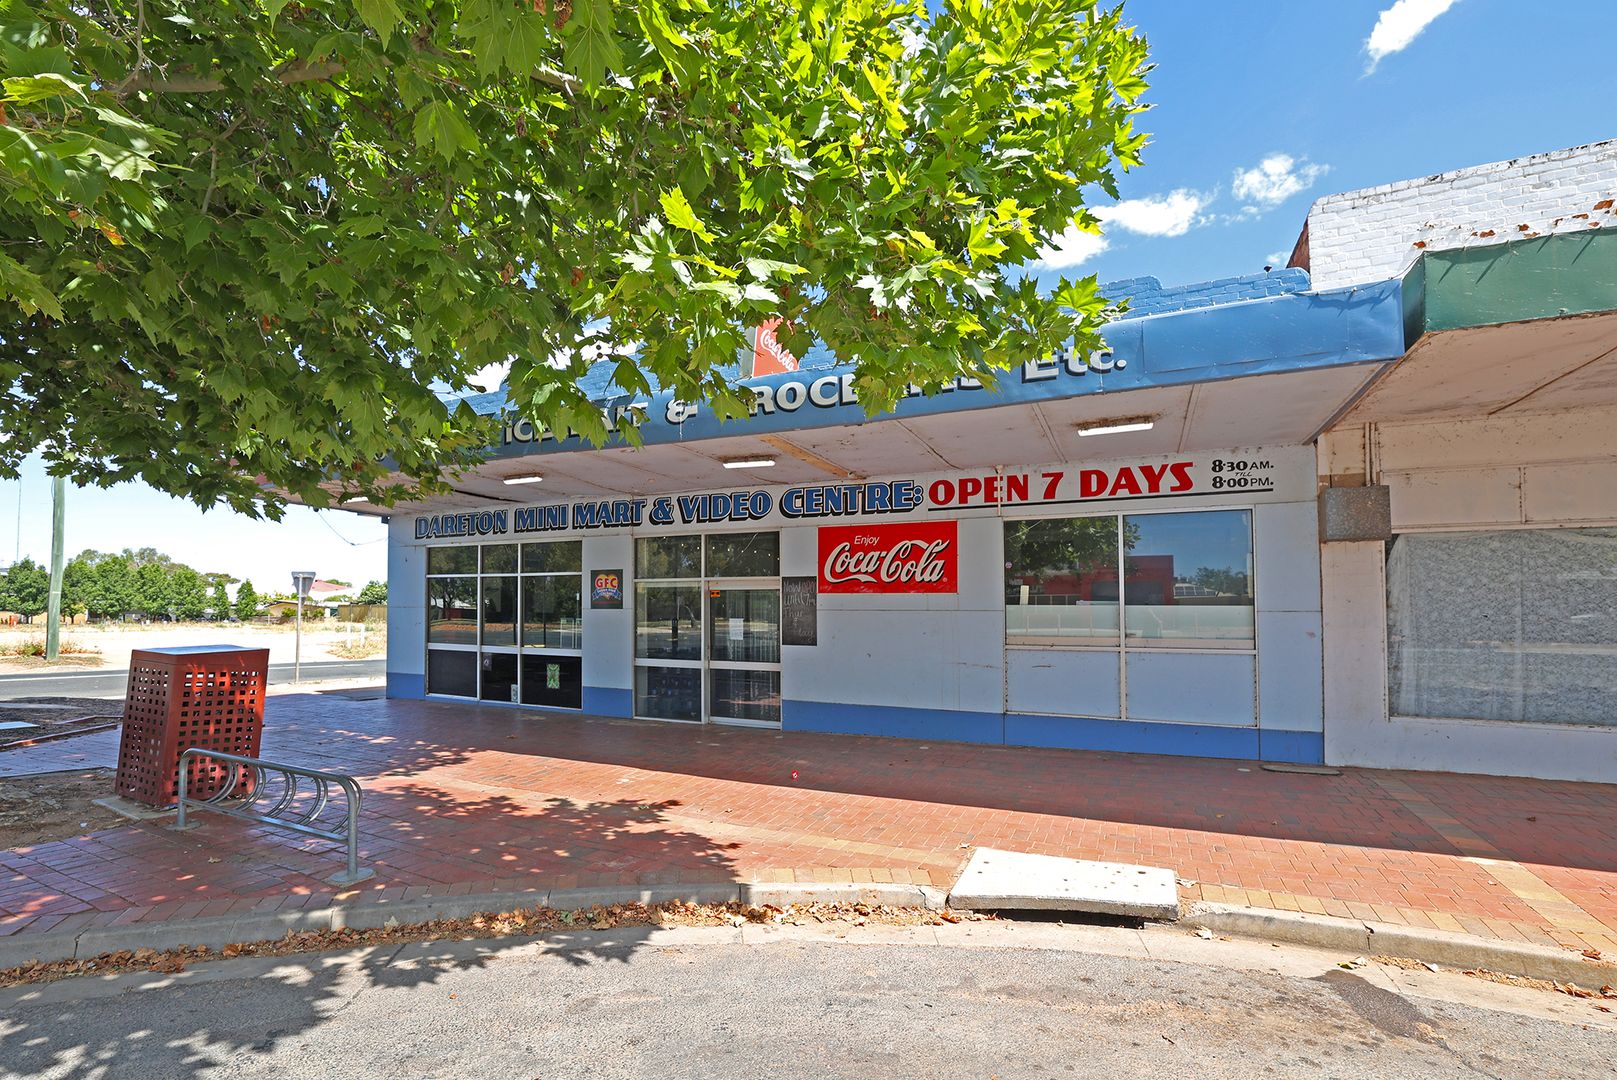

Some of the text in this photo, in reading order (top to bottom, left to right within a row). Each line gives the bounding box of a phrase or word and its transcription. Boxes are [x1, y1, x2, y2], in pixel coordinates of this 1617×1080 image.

[666, 397, 699, 426] &
[928, 461, 1194, 506] OPEN 7 DAYS
[414, 508, 510, 540] DARETON
[513, 503, 570, 534] MINI
[573, 498, 648, 530] MART
[650, 496, 675, 525] &
[677, 490, 773, 524] VIDEO
[854, 535, 880, 546] Enjoy
[823, 539, 950, 583] Coca-Cola
[595, 577, 619, 589] GFC
